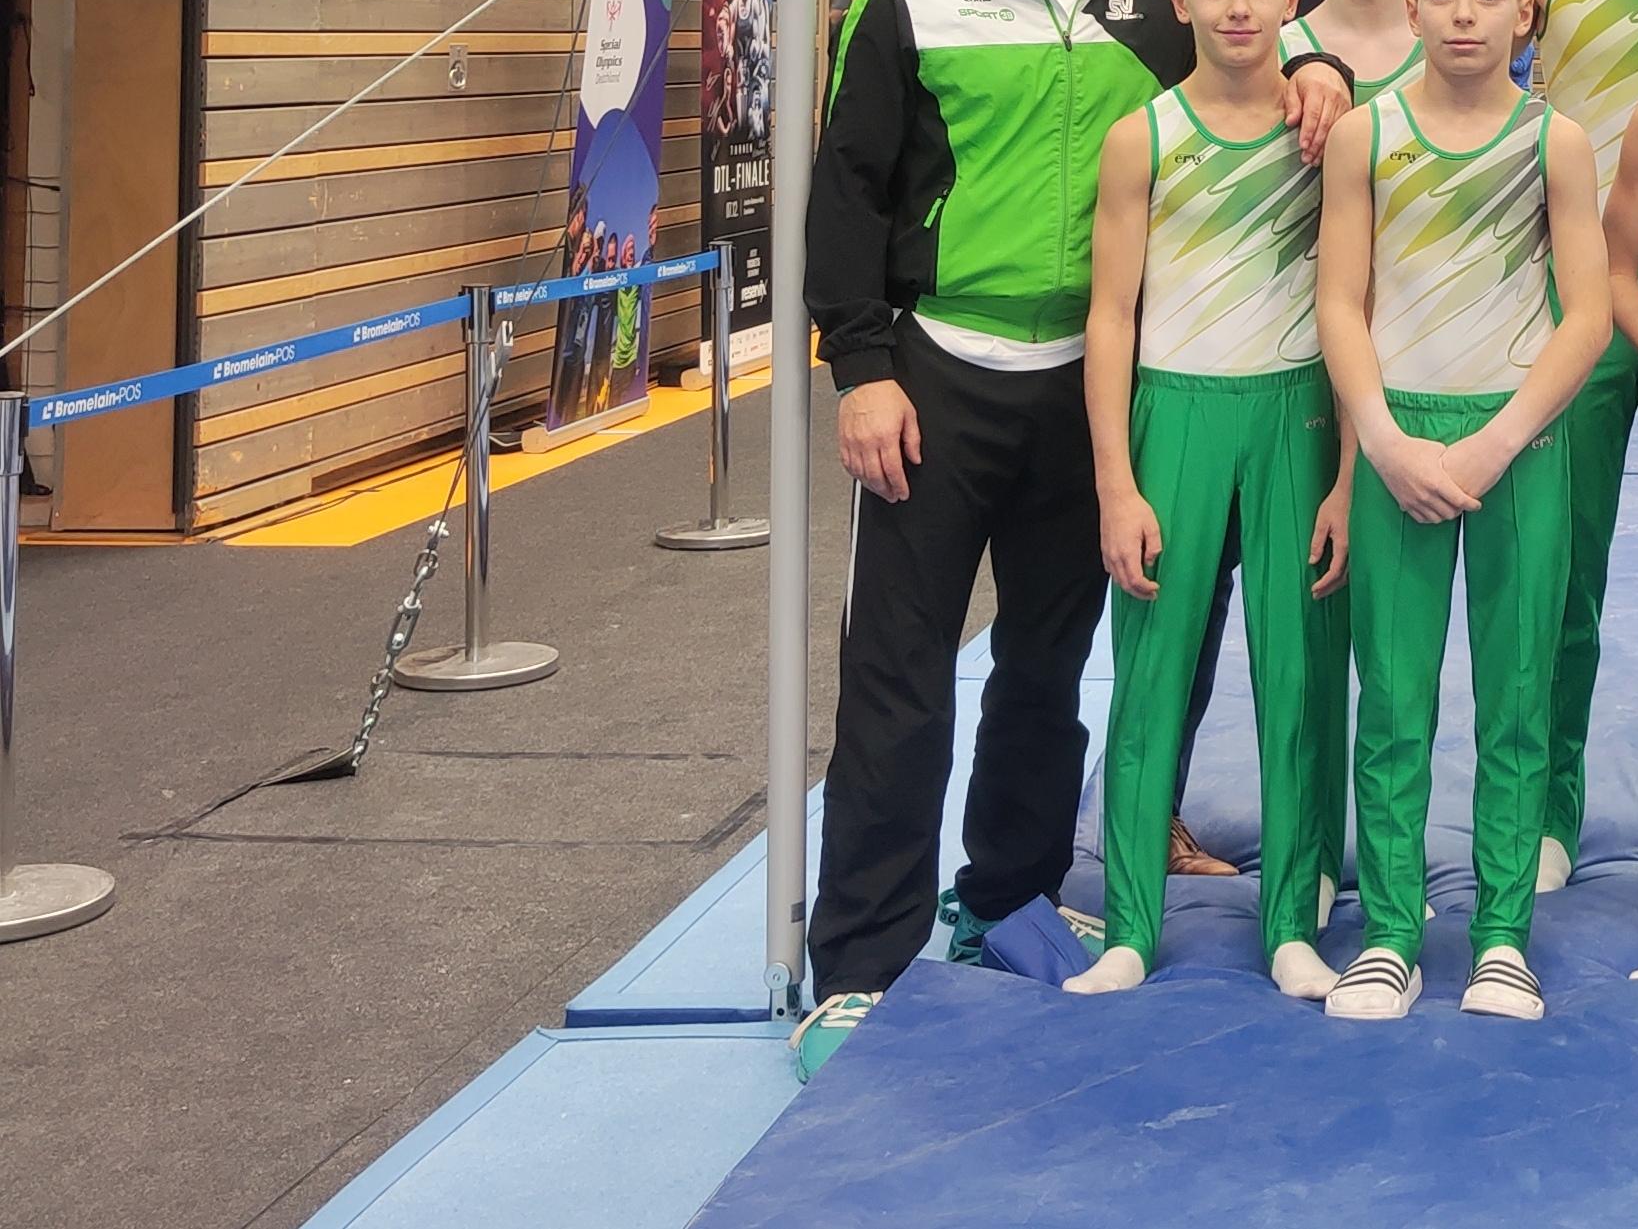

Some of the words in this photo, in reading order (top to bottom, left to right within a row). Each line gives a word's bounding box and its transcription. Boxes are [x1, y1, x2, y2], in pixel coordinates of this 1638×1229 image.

[959, 8, 998, 20] SPORT
[714, 159, 770, 194] DTL-FINALE
[223, 344, 295, 378] Bromelain-POS
[54, 382, 142, 418] Bromelain-POS
